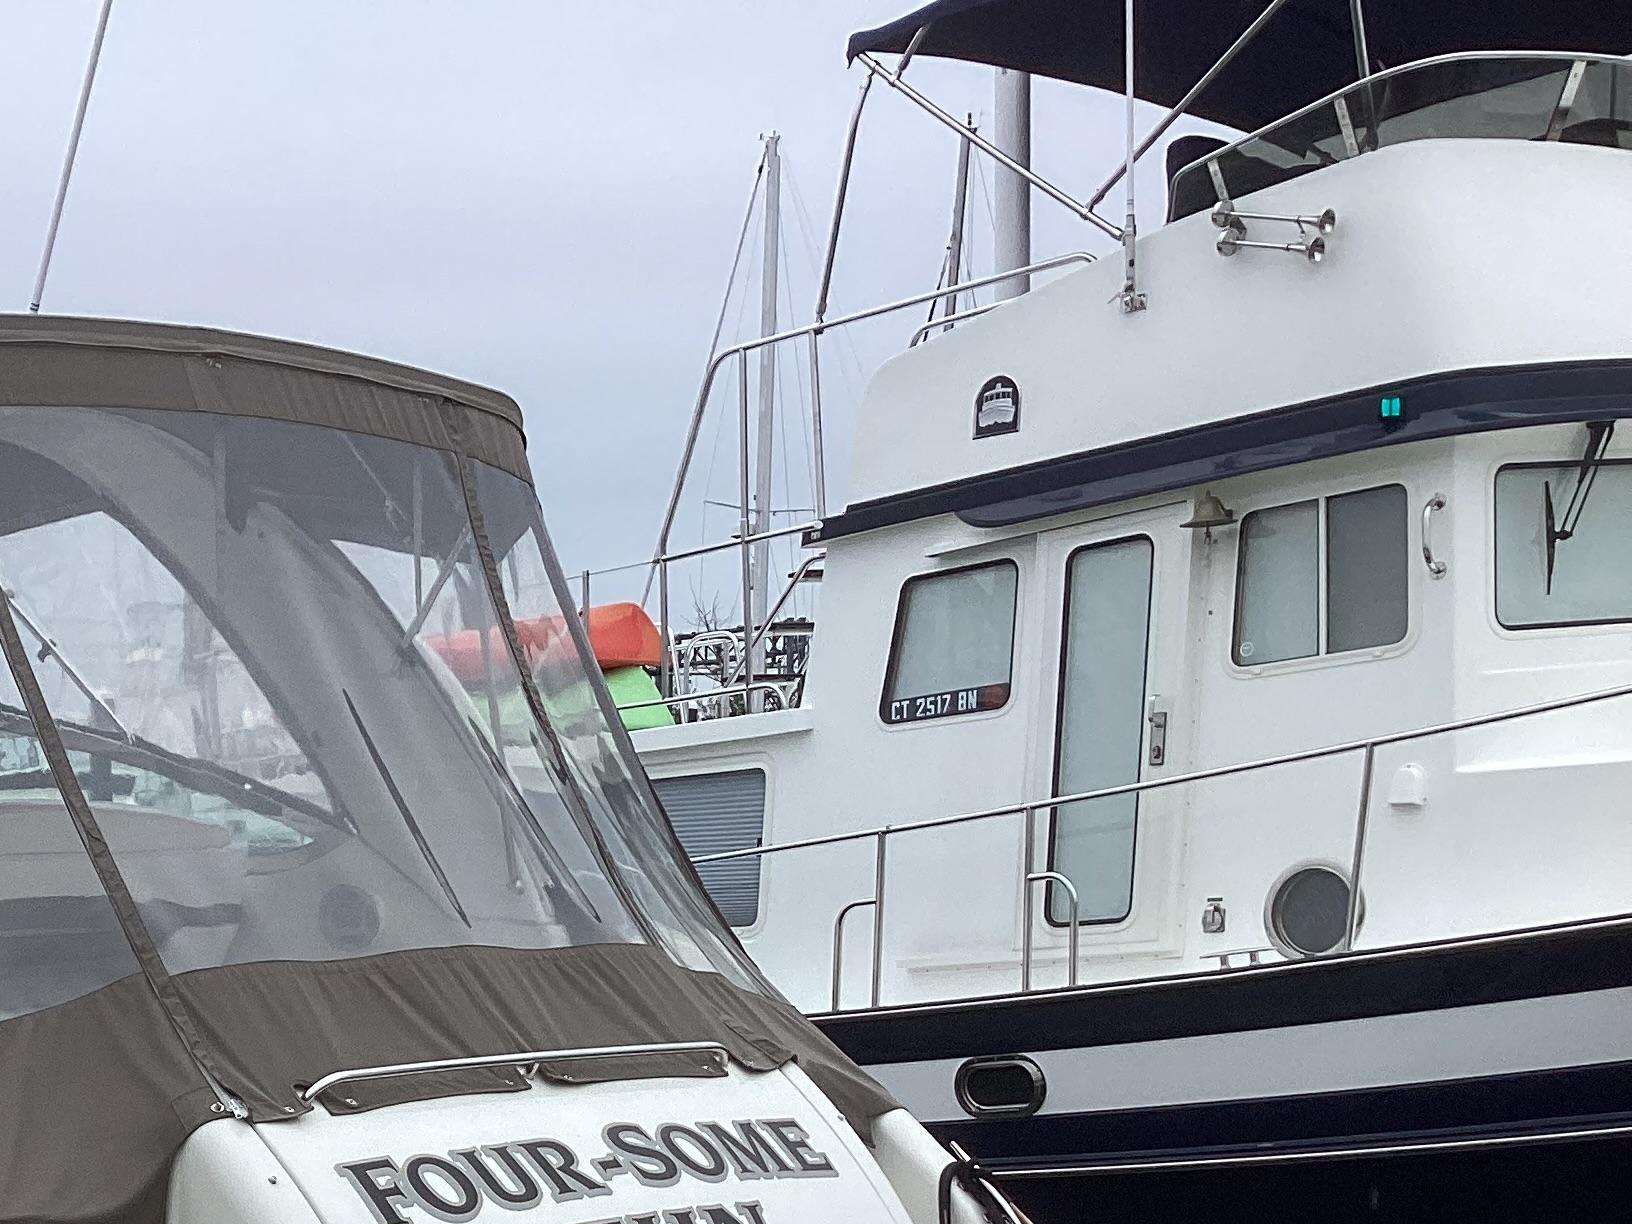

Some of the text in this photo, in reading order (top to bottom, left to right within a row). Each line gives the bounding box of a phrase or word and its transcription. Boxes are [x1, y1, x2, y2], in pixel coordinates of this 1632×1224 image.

[891, 689, 978, 720] CT 2517 BN
